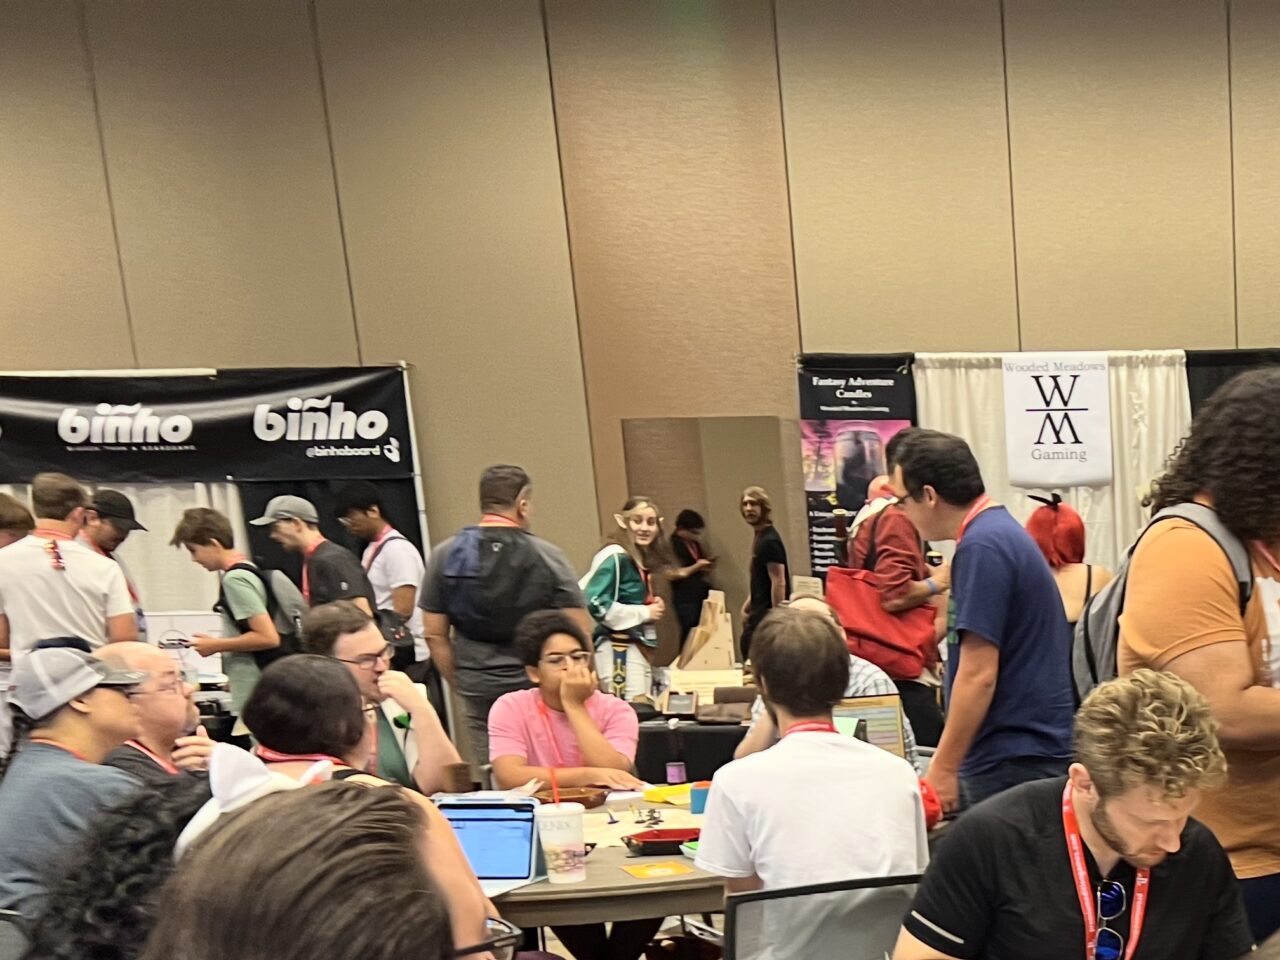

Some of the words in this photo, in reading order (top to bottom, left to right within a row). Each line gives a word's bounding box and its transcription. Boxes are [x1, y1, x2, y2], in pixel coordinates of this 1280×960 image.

[1004, 362, 1049, 372] Wooded
[1053, 361, 1106, 371] Meadows
[57, 402, 193, 444] binho
[253, 395, 389, 442] binho
[1031, 448, 1087, 462] Gaming
